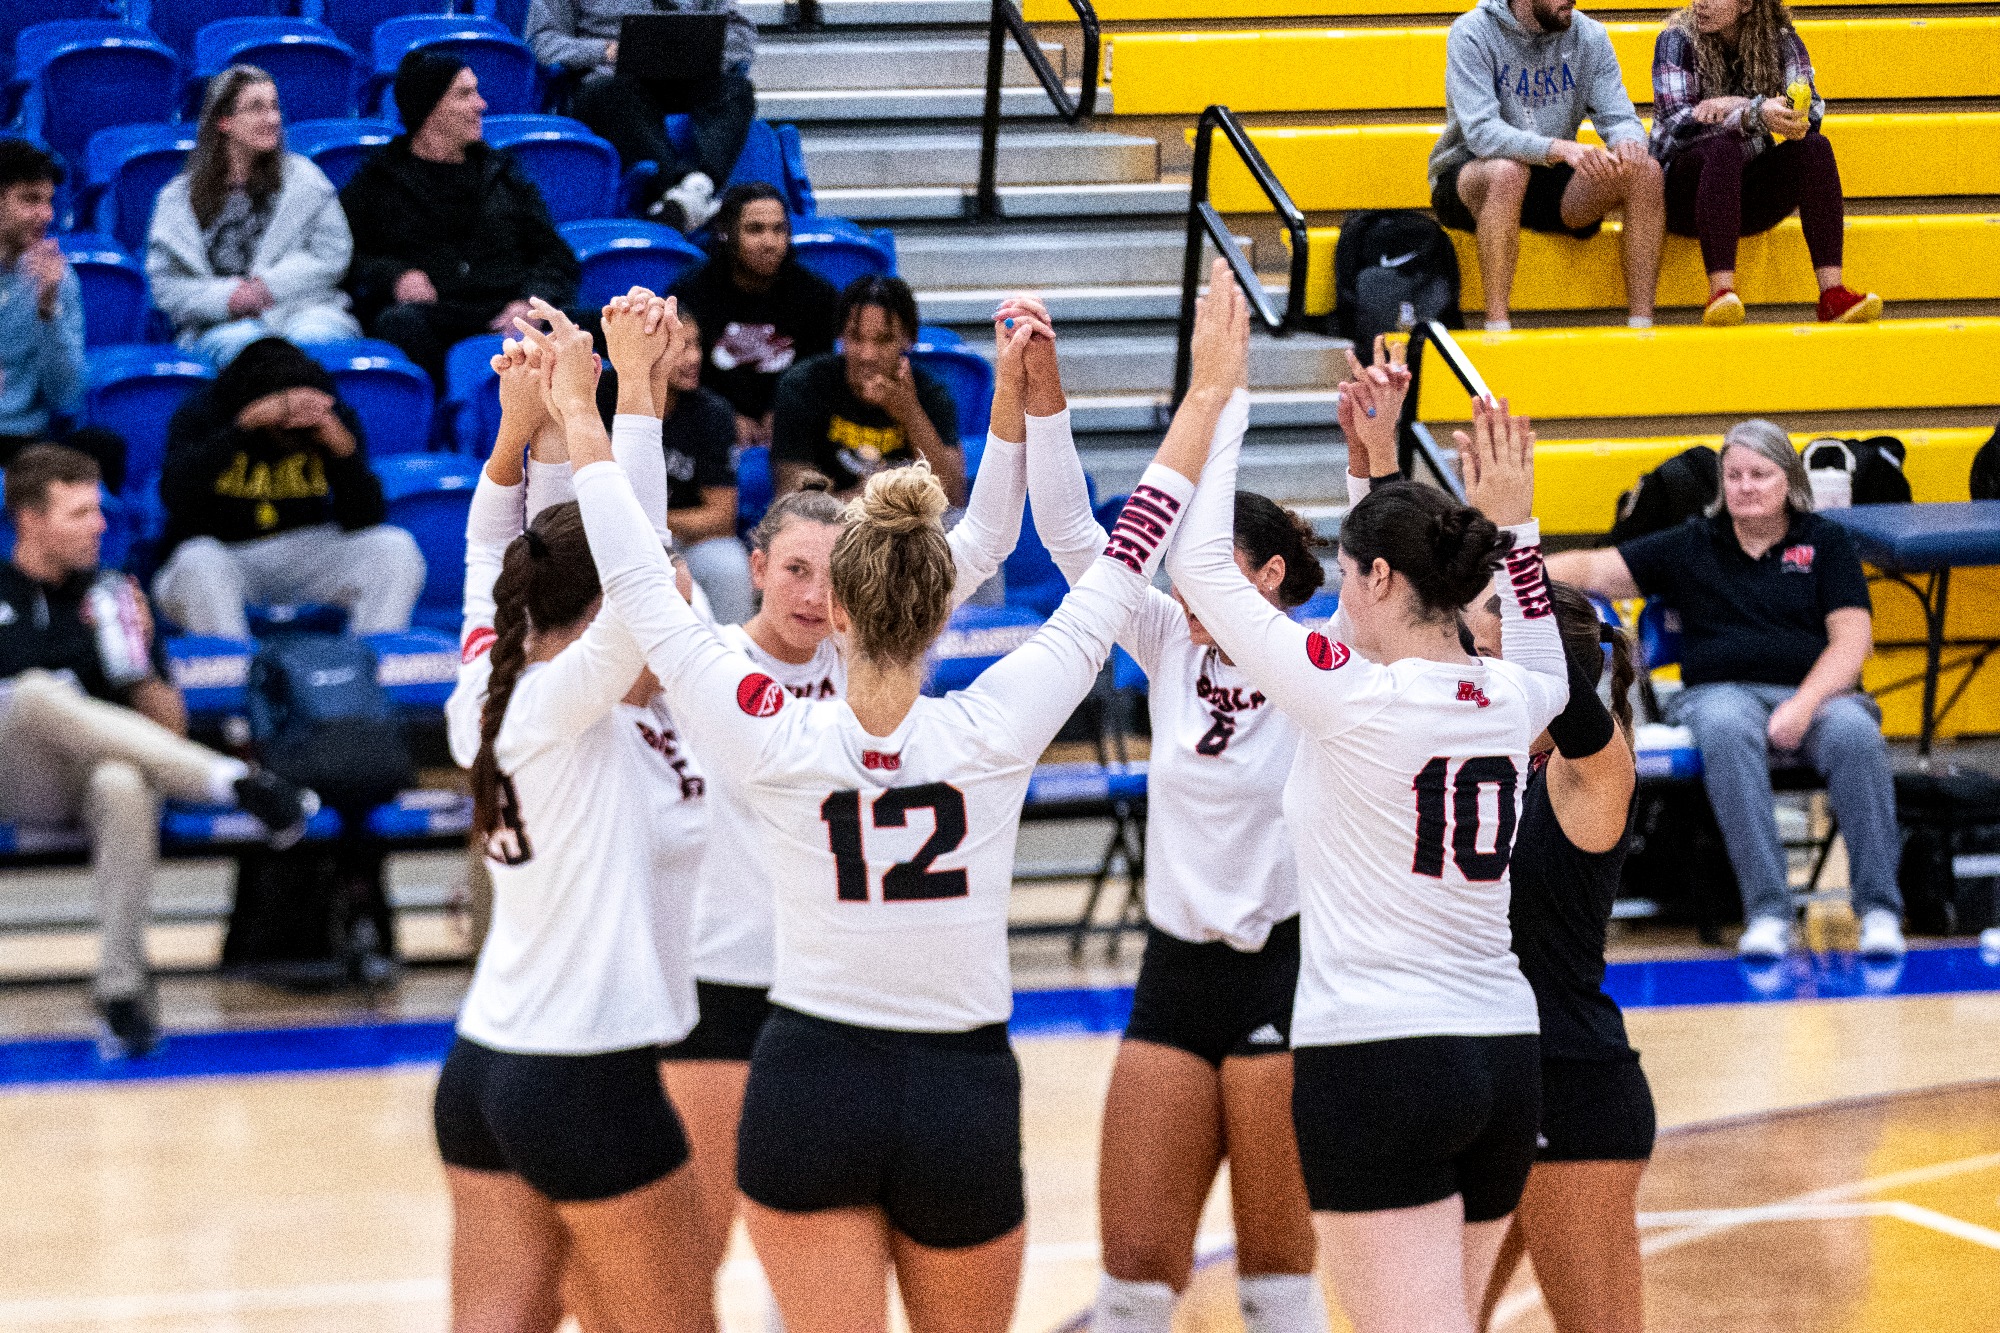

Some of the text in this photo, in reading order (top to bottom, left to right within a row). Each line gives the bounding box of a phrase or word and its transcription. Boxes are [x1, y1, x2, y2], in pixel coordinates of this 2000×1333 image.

[1499, 62, 1576, 97] AASKA
[1102, 484, 1181, 575] EAGLES
[1505, 543, 1553, 619] EAGLES
[820, 779, 970, 904] 12
[1411, 755, 1520, 882] 10
